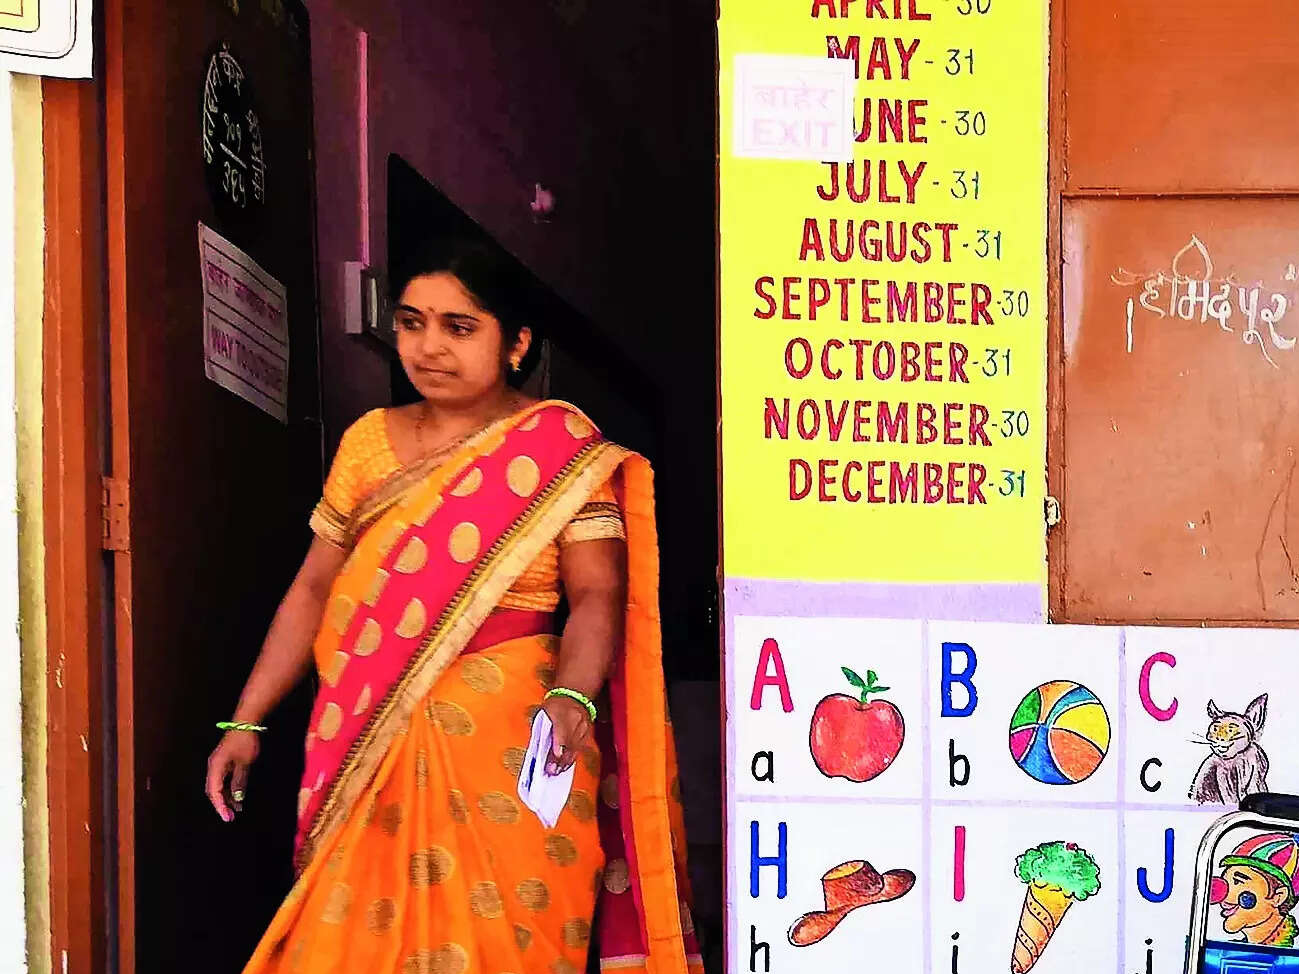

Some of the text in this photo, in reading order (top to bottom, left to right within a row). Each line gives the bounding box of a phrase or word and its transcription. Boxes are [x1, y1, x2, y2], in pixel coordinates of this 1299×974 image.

[826, 35, 921, 81] MAY
[752, 118, 837, 148] EXIT
[853, 98, 929, 144] UNE
[816, 160, 928, 204] JULY
[799, 218, 959, 264] AUGUST
[753, 276, 995, 326] SEPTEMBER
[784, 337, 970, 384] OCTOBER
[764, 397, 993, 447] NOVEMBER
[789, 458, 987, 505] DECEMBER
[750, 638, 796, 713] A
[940, 642, 979, 718] B
[1138, 652, 1179, 722] C
[751, 749, 776, 783] a
[948, 739, 971, 787] b
[750, 820, 788, 899] H
[1137, 827, 1175, 903] J
[749, 925, 771, 974] h
